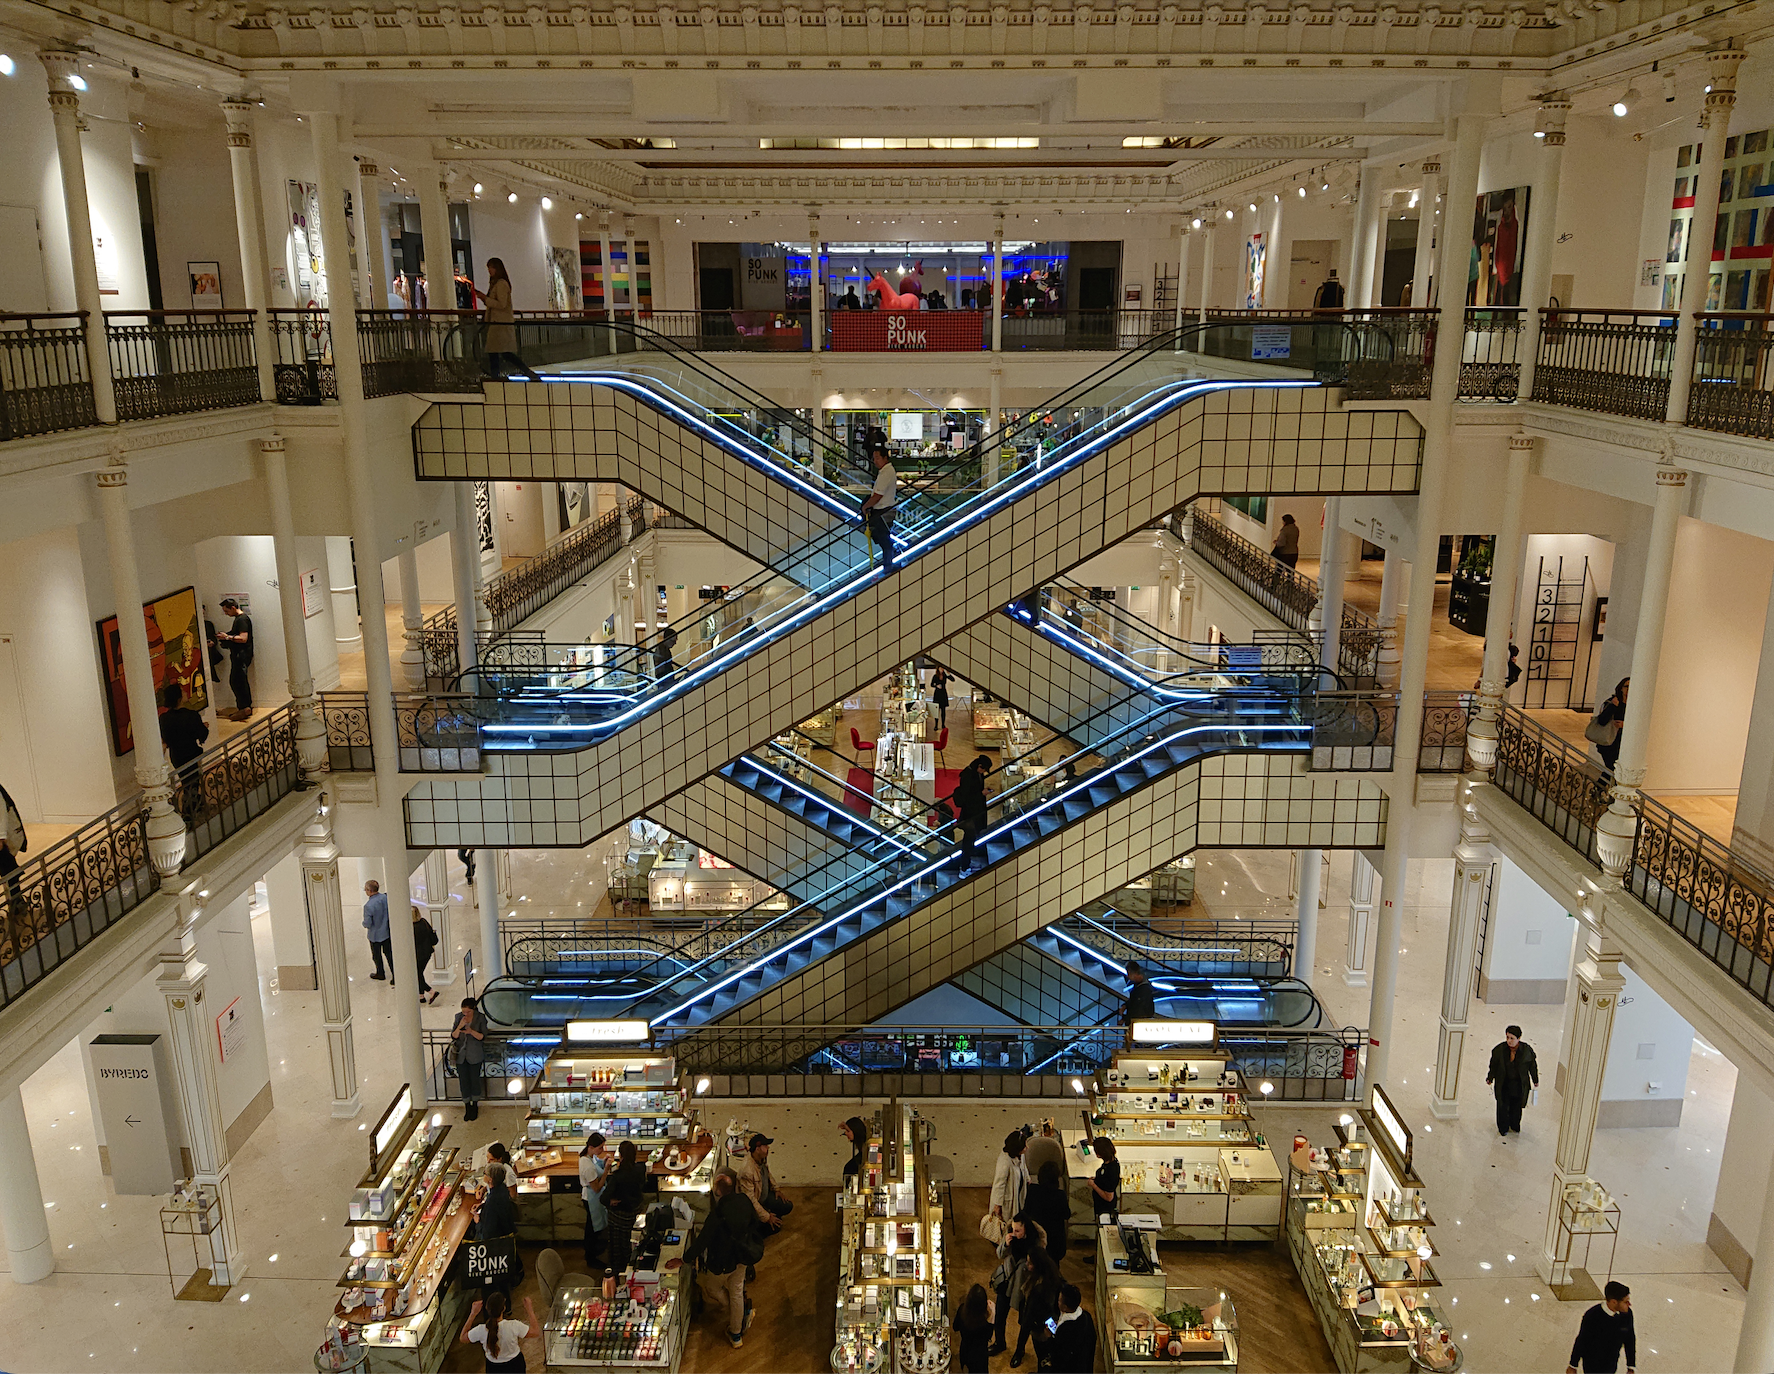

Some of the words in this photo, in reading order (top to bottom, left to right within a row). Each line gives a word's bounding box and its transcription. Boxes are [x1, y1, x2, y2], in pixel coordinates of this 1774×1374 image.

[748, 258, 762, 269] SO
[748, 269, 778, 280] PUNK
[1157, 281, 1163, 290] 3
[1156, 291, 1163, 300] 2
[1157, 301, 1161, 309] 1
[888, 315, 906, 330] SO
[888, 330, 927, 344] PUNK
[1542, 588, 1553, 604] 3
[1539, 608, 1551, 623] 2
[1539, 627, 1547, 642] 1
[1535, 645, 1545, 660] 0
[1529, 664, 1542, 679] -1
[100, 1068, 149, 1079] BYREDO
[468, 1244, 487, 1260] SO
[468, 1254, 508, 1273] PUNK
